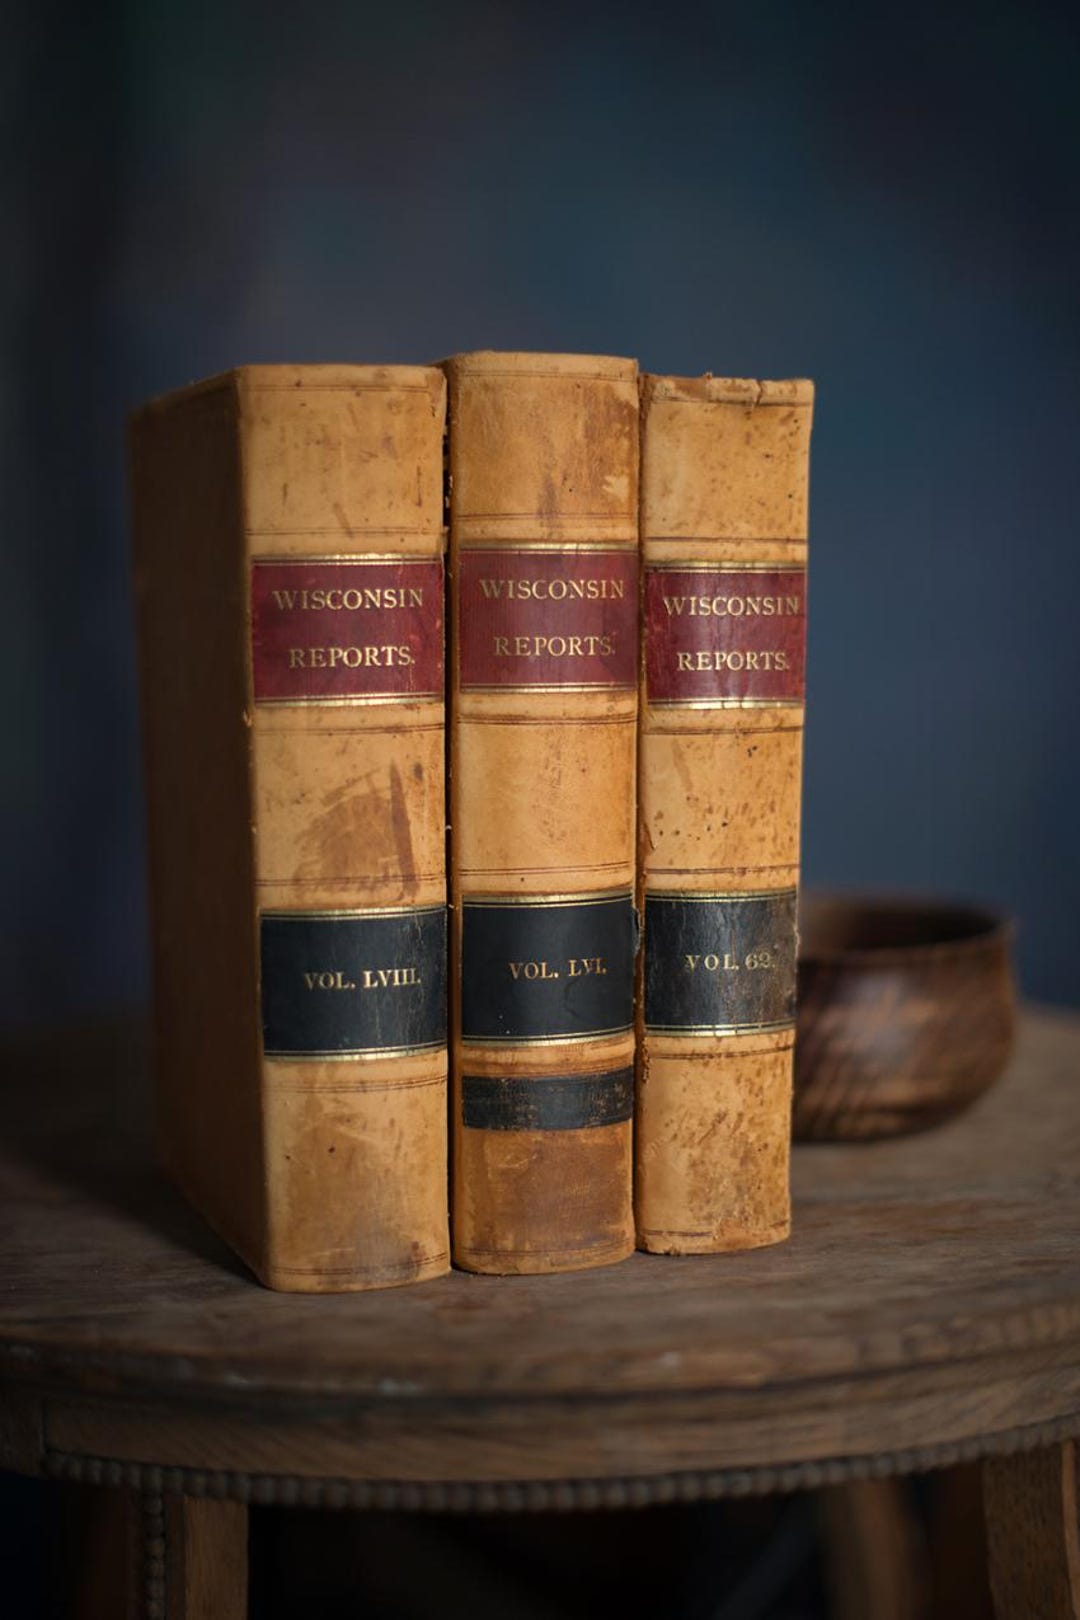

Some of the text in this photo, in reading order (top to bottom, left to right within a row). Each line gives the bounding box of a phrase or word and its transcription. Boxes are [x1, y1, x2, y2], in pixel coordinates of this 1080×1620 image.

[271, 588, 423, 610] WISCONSIN
[479, 579, 624, 600] WISCONSIN
[663, 596, 799, 616] WISCONSIN
[289, 646, 416, 668] REPORTS.
[677, 651, 790, 671] REPORTS.
[509, 957, 607, 980] VOL. LVI.
[685, 954, 740, 972] VOL.
[304, 967, 422, 990] VOL. LVIII.
